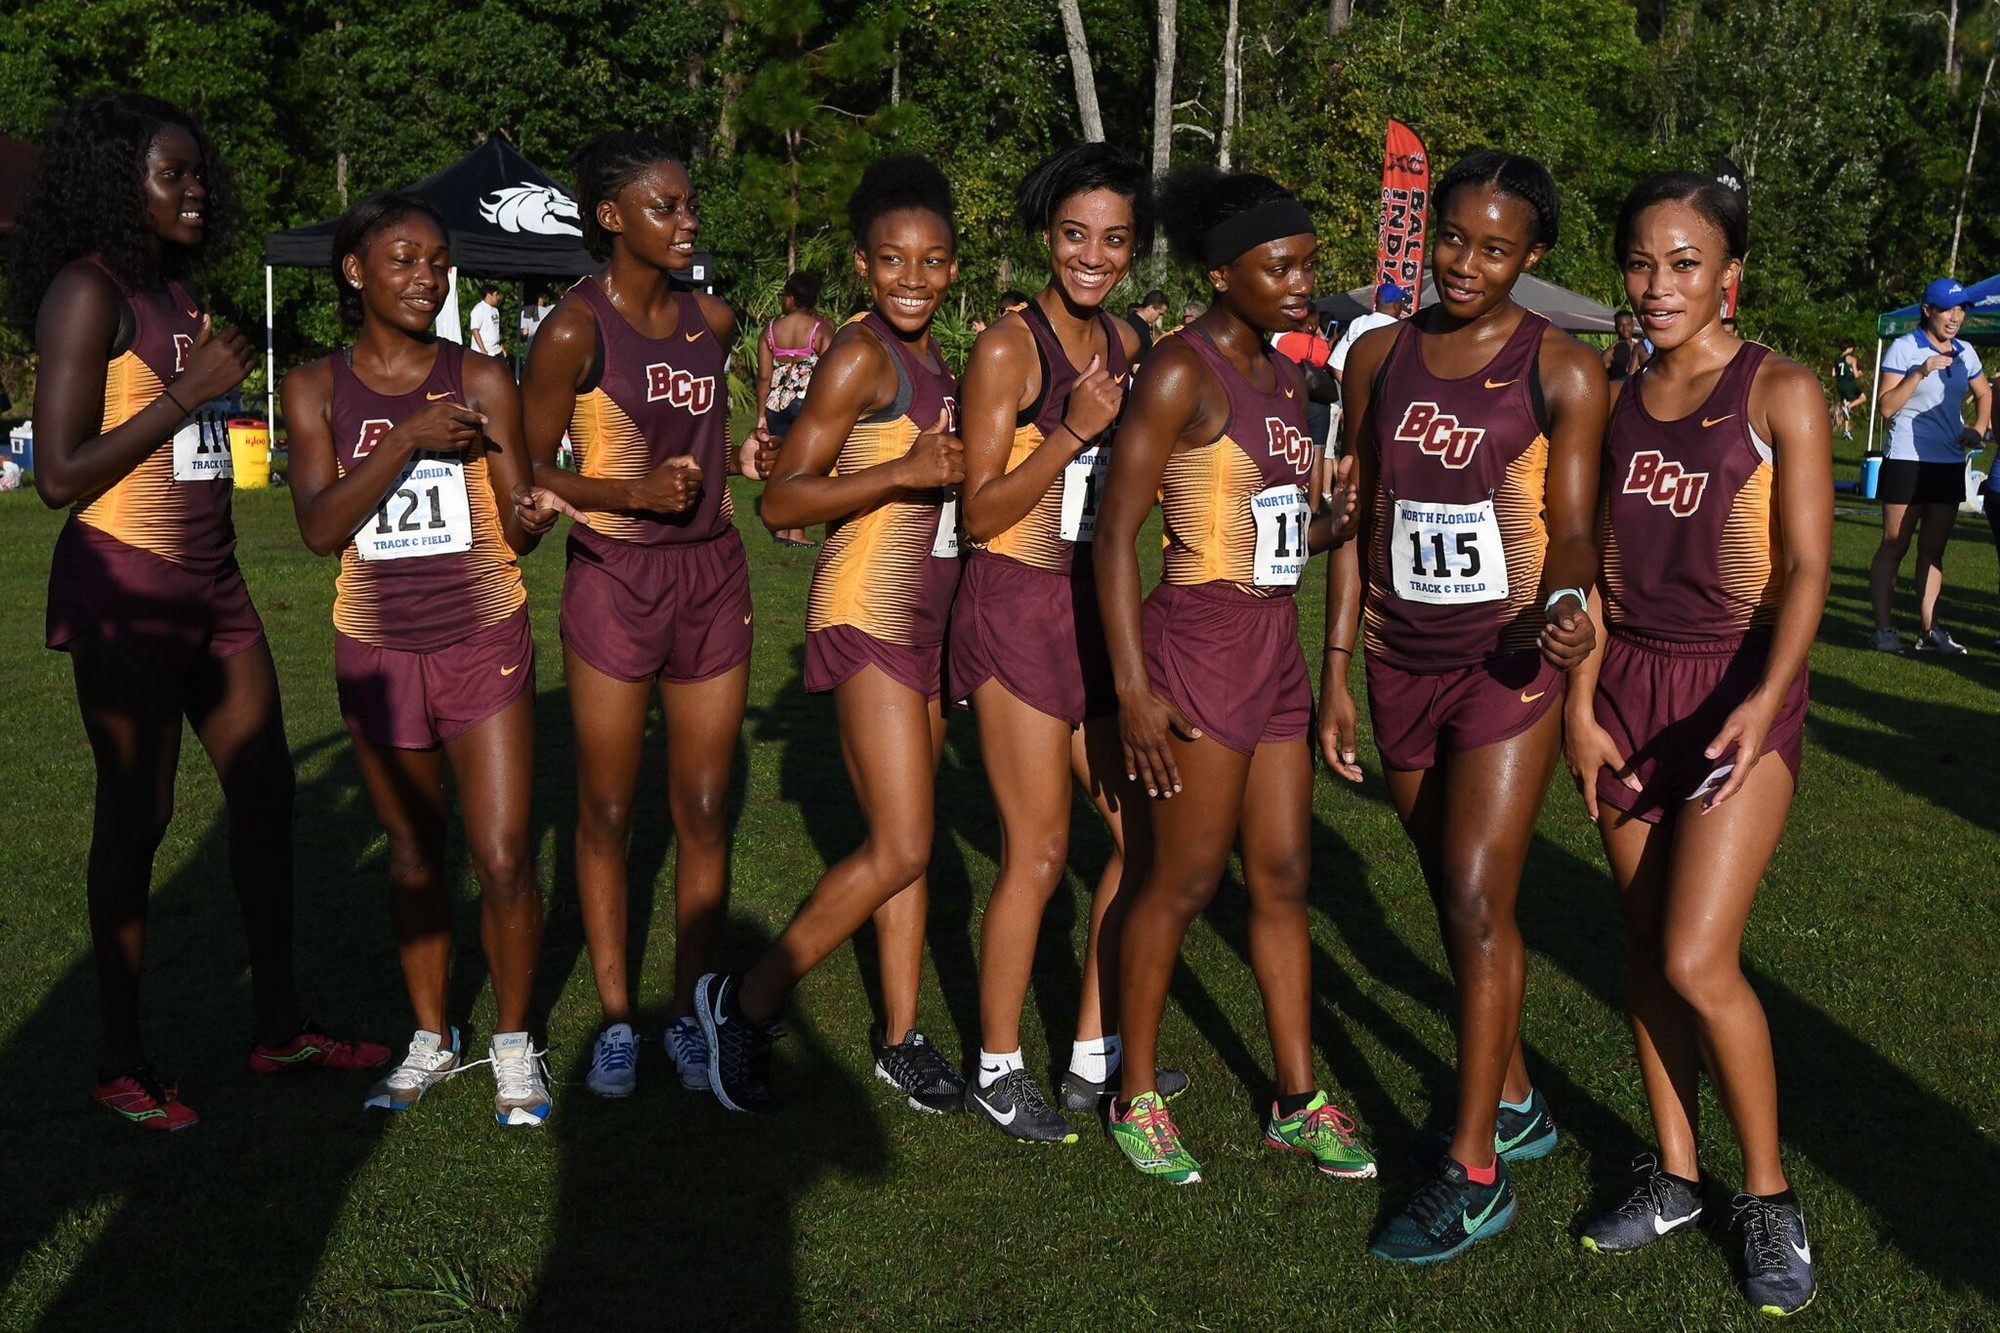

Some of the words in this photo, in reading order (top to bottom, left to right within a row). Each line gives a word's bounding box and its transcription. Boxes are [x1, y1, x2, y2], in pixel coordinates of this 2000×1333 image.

[1382, 189, 1410, 286] INDIA
[1397, 188, 1427, 318] BALDW
[1838, 362, 1845, 376] 7
[646, 362, 715, 416] BCU
[1265, 416, 1314, 475] BCU
[1394, 401, 1486, 470] BCU
[192, 459, 219, 470] TRACK
[402, 467, 453, 481] FLORIDA
[1622, 450, 1709, 518] BCU
[375, 485, 446, 534] 121
[1255, 494, 1294, 508] NORTH
[1401, 509, 1434, 523] NORTH
[1435, 510, 1485, 524] FLORIDA
[373, 538, 410, 550] TRACK
[422, 534, 452, 546] FIELD
[1079, 522, 1094, 531] TRA
[1410, 531, 1481, 578] 115
[1409, 580, 1442, 593] TRACK
[1454, 582, 1486, 593] FIELD
